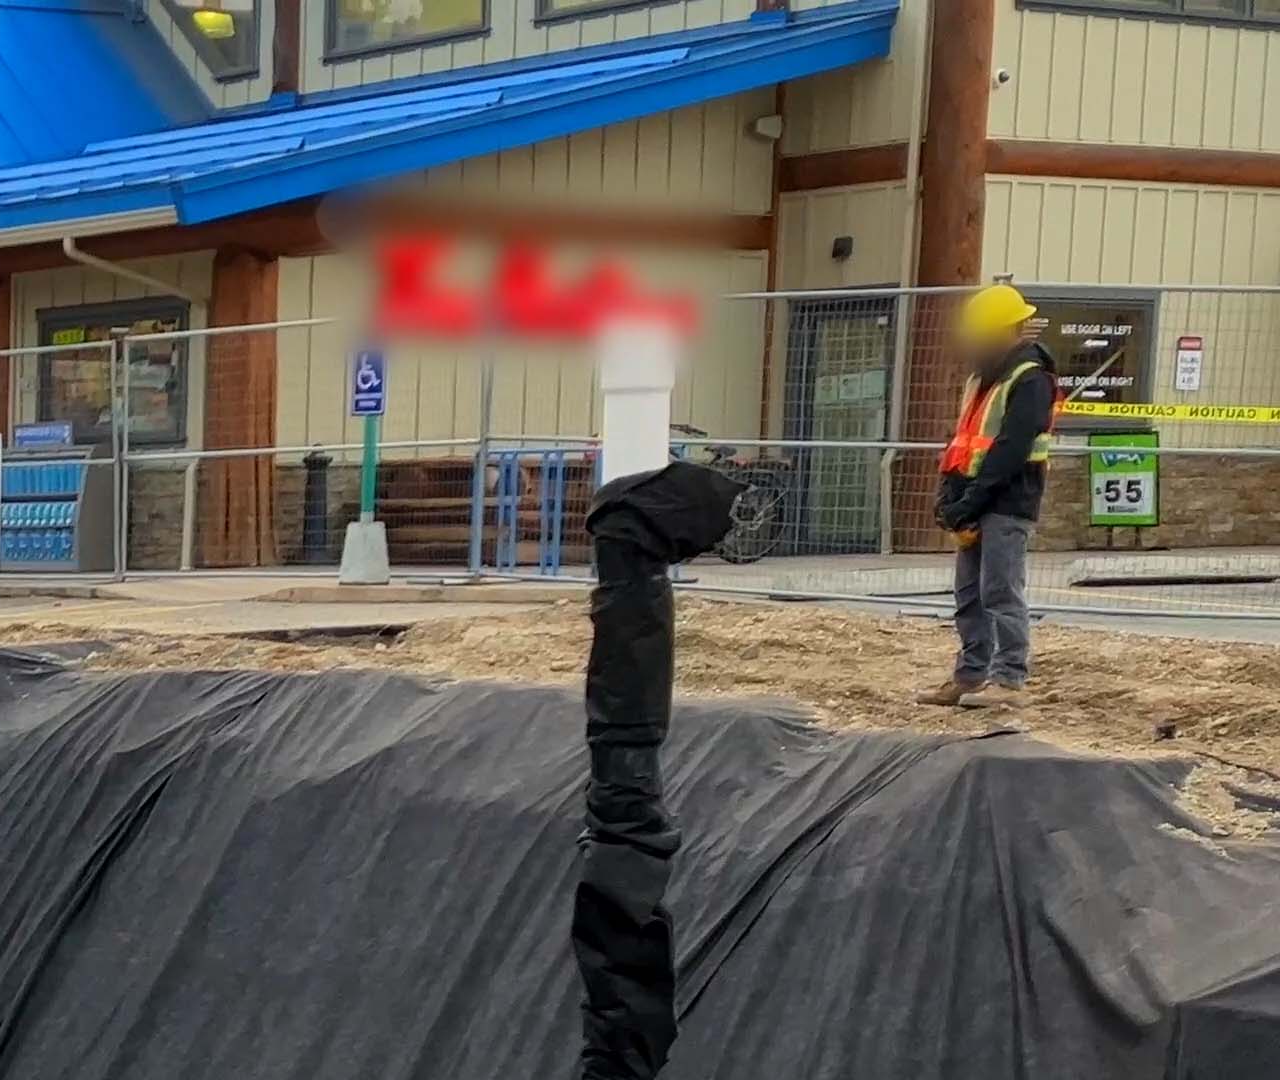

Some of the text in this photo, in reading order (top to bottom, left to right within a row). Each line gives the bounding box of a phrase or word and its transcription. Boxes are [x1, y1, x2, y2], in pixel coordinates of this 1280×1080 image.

[1061, 324, 1077, 335] USE
[1077, 324, 1101, 335] DOOR
[1114, 324, 1133, 335] LEFT
[1058, 376, 1074, 387] USE
